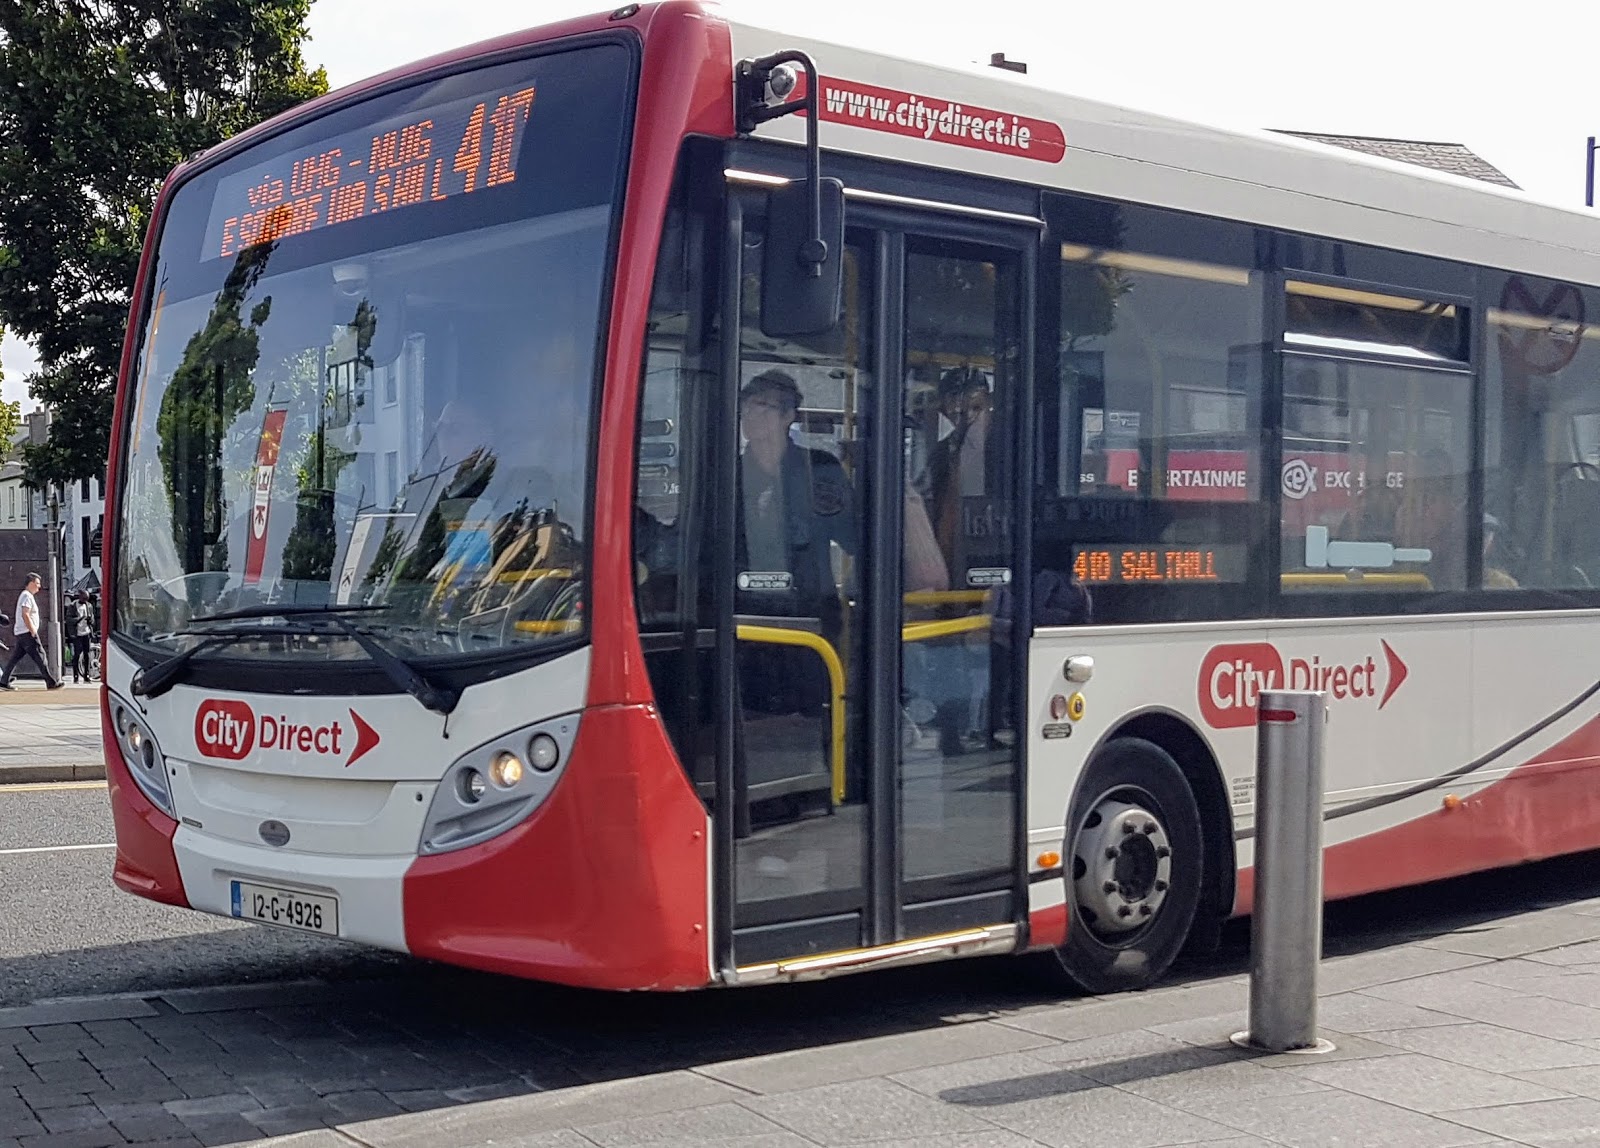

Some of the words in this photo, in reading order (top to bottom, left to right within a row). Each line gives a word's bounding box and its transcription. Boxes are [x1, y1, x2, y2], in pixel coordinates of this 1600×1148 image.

[825, 87, 1031, 150] www.citydirect.ie
[248, 174, 283, 207] via
[1073, 551, 1112, 581] 410
[1289, 655, 1376, 700] Direct
[202, 710, 248, 754] City
[259, 715, 342, 755] Direct
[252, 892, 322, 929] 12-G-4926
